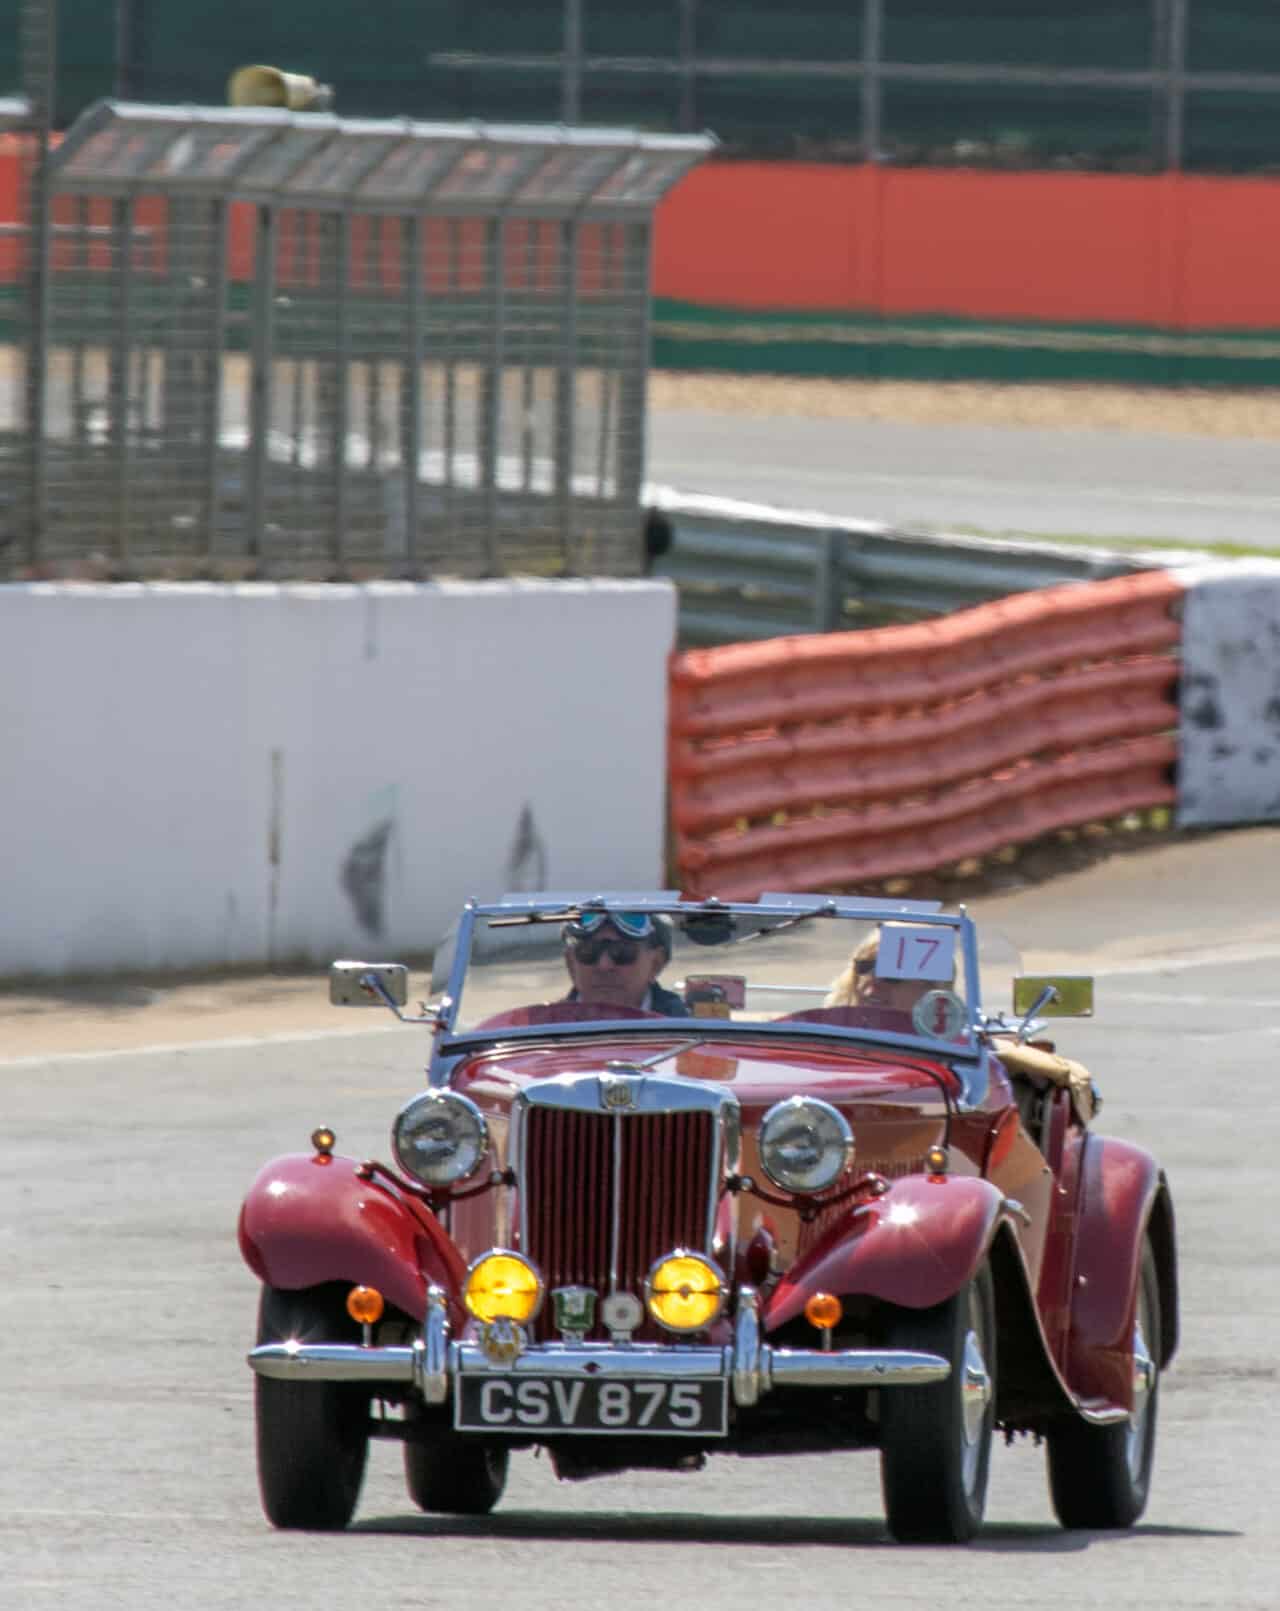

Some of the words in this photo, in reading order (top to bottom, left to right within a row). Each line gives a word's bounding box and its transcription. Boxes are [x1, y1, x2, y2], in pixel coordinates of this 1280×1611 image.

[896, 936, 941, 971] 17
[480, 1380, 584, 1423] CSV
[598, 1383, 702, 1427] 875
